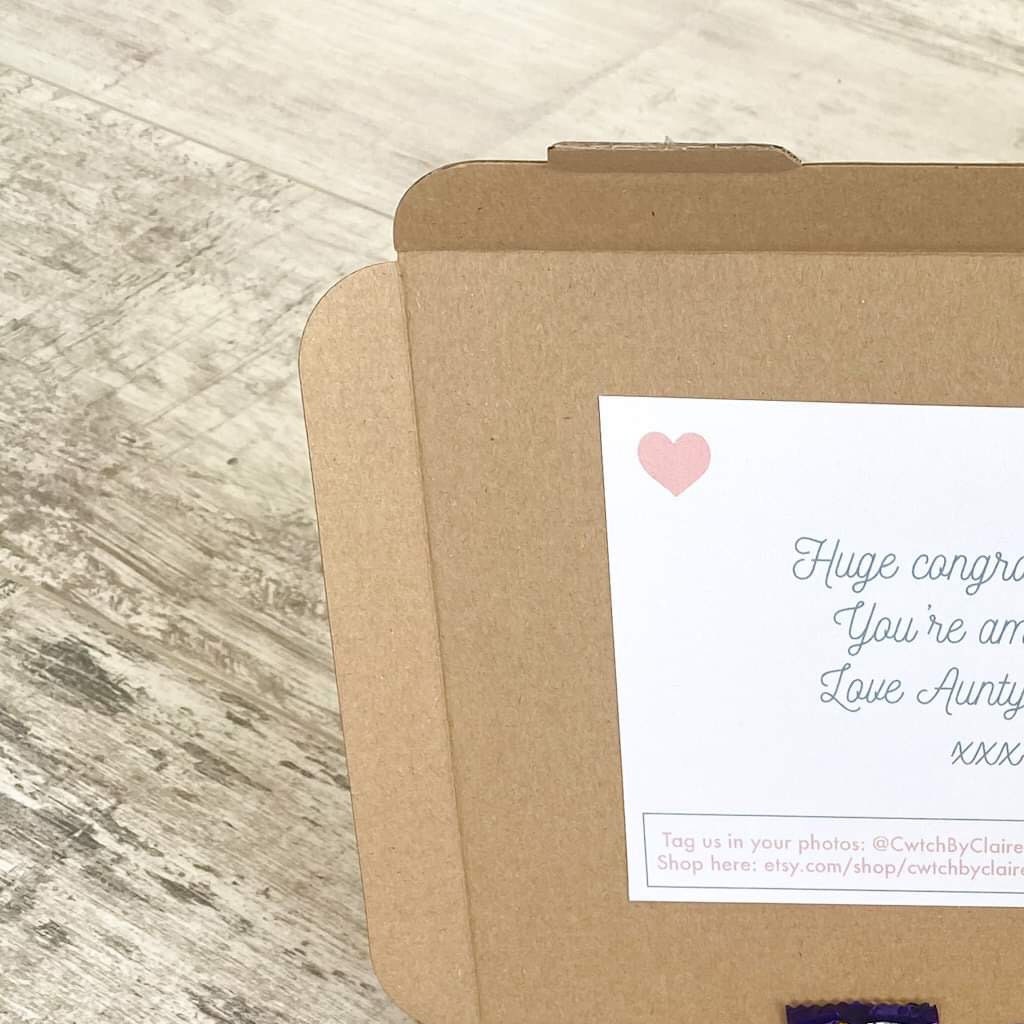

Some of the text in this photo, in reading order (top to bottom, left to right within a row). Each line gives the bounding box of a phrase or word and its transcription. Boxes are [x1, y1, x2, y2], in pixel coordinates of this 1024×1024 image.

[792, 536, 899, 593] Huge
[833, 600, 966, 656] You're
[820, 662, 905, 712] Love
[657, 854, 703, 876] Shop
[711, 856, 757, 873] here:
[661, 832, 1024, 858] Tag us in your photos: @CwtchByClaire
